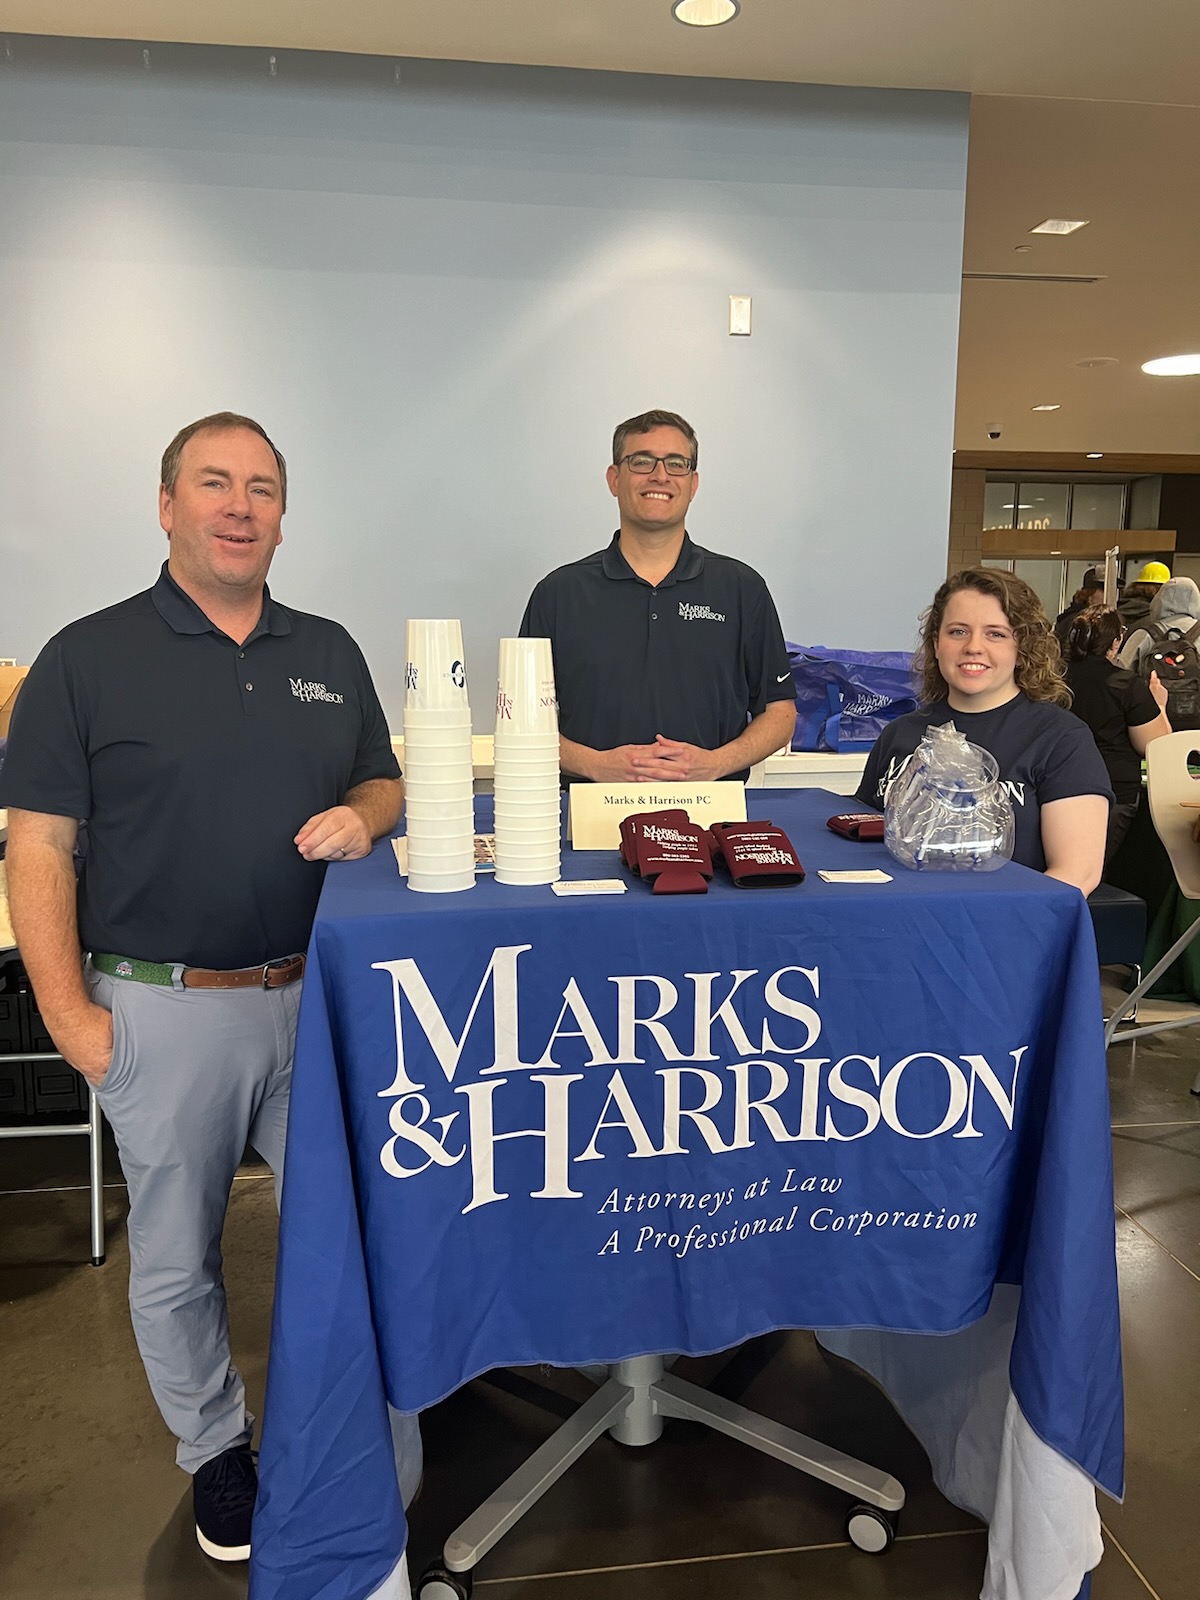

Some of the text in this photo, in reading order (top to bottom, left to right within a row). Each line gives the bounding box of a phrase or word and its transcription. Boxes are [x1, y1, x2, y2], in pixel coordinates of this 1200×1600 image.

[288, 677, 327, 691] MARKS
[603, 795, 712, 805] Marks & Harrison PC
[643, 825, 679, 836] MARKS
[370, 943, 822, 1098] MARKS
[597, 1168, 843, 1217] Attorneys at Law
[597, 1205, 978, 1259] A Professional Corporation
